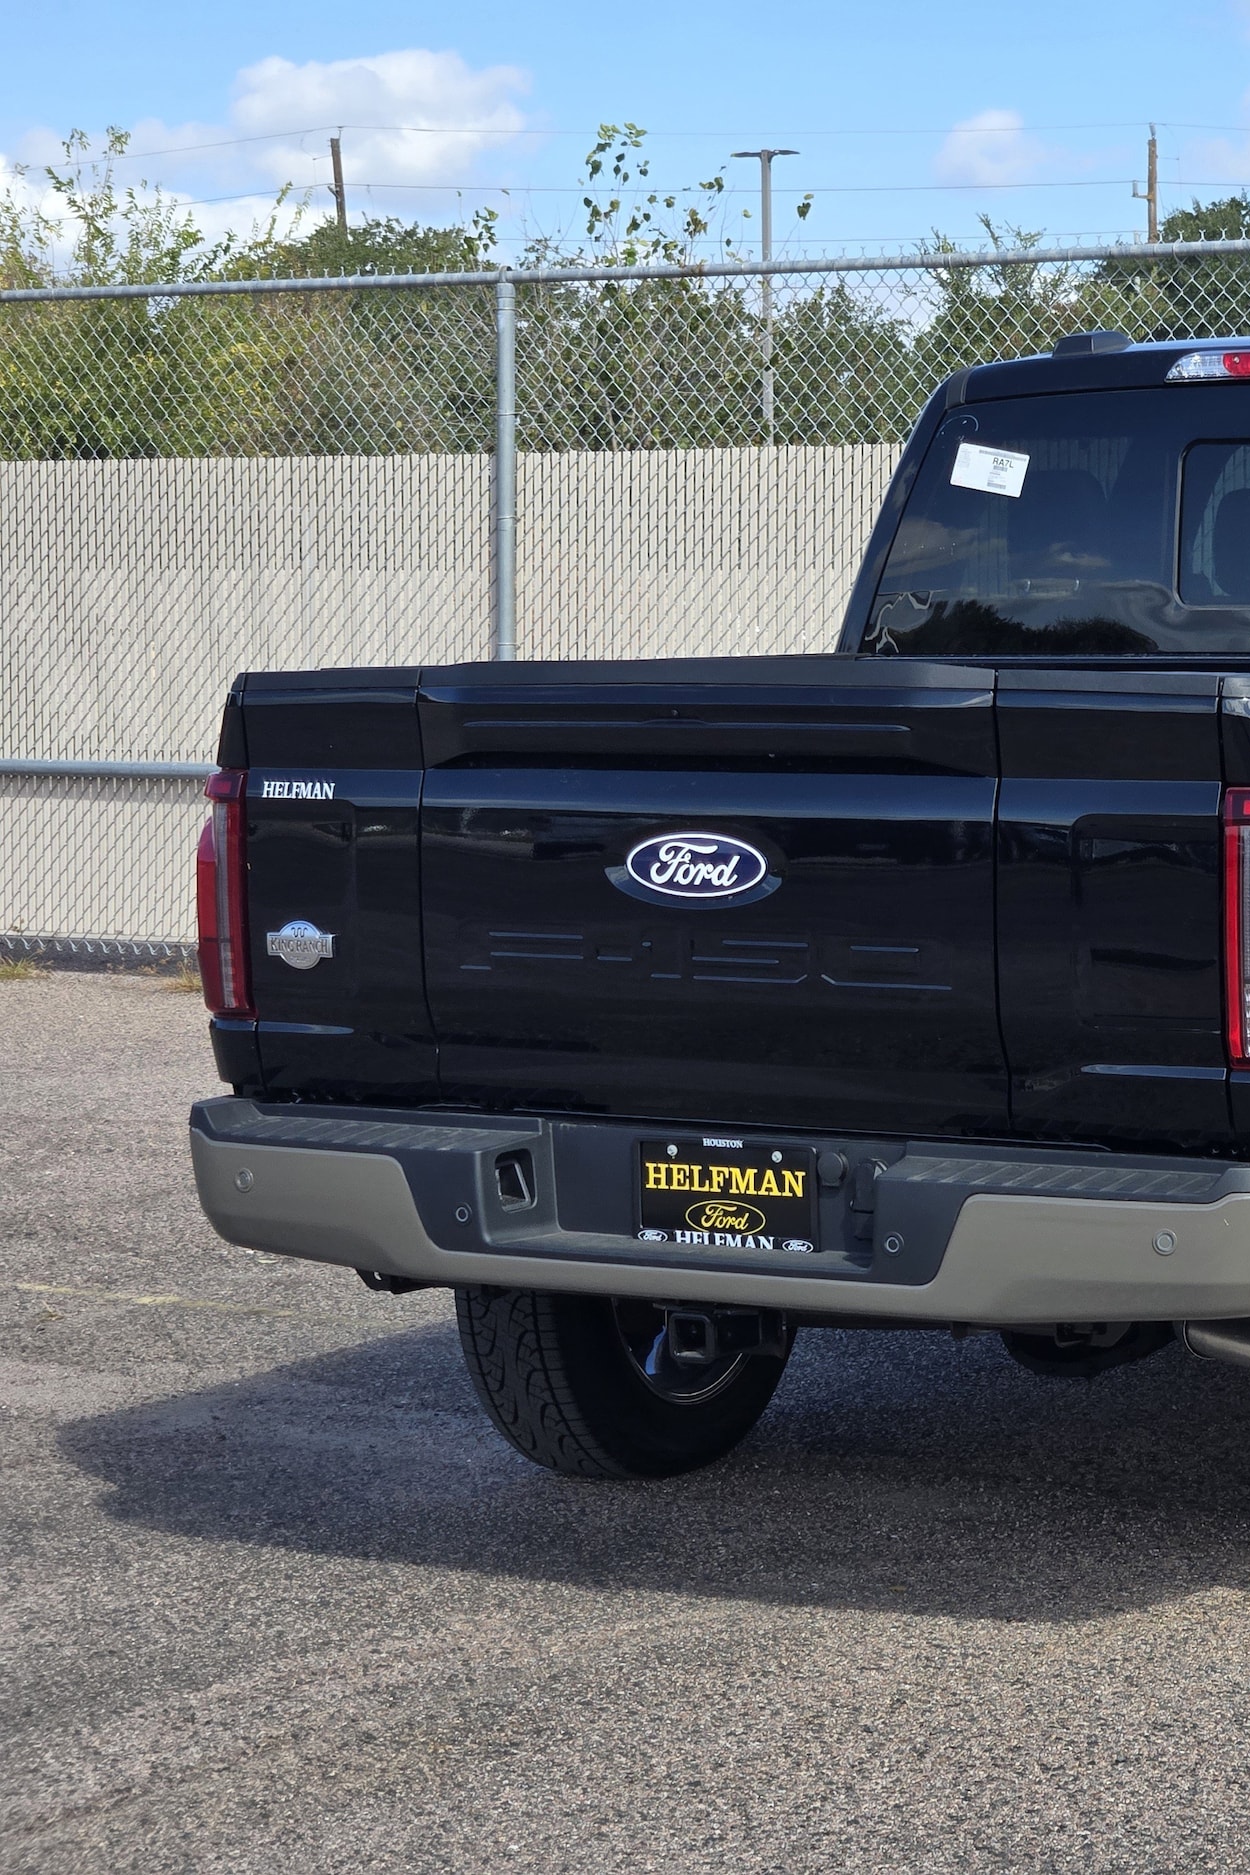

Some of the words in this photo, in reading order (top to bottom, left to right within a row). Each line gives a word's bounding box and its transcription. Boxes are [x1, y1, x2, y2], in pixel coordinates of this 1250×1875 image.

[262, 781, 335, 800] HELFMAN
[650, 841, 741, 887] Ford
[271, 937, 295, 952] KING
[296, 939, 328, 954] RANCH
[703, 1138, 743, 1149] HOUSTON
[645, 1162, 806, 1198] HELFMAN
[701, 1204, 750, 1231] Ford
